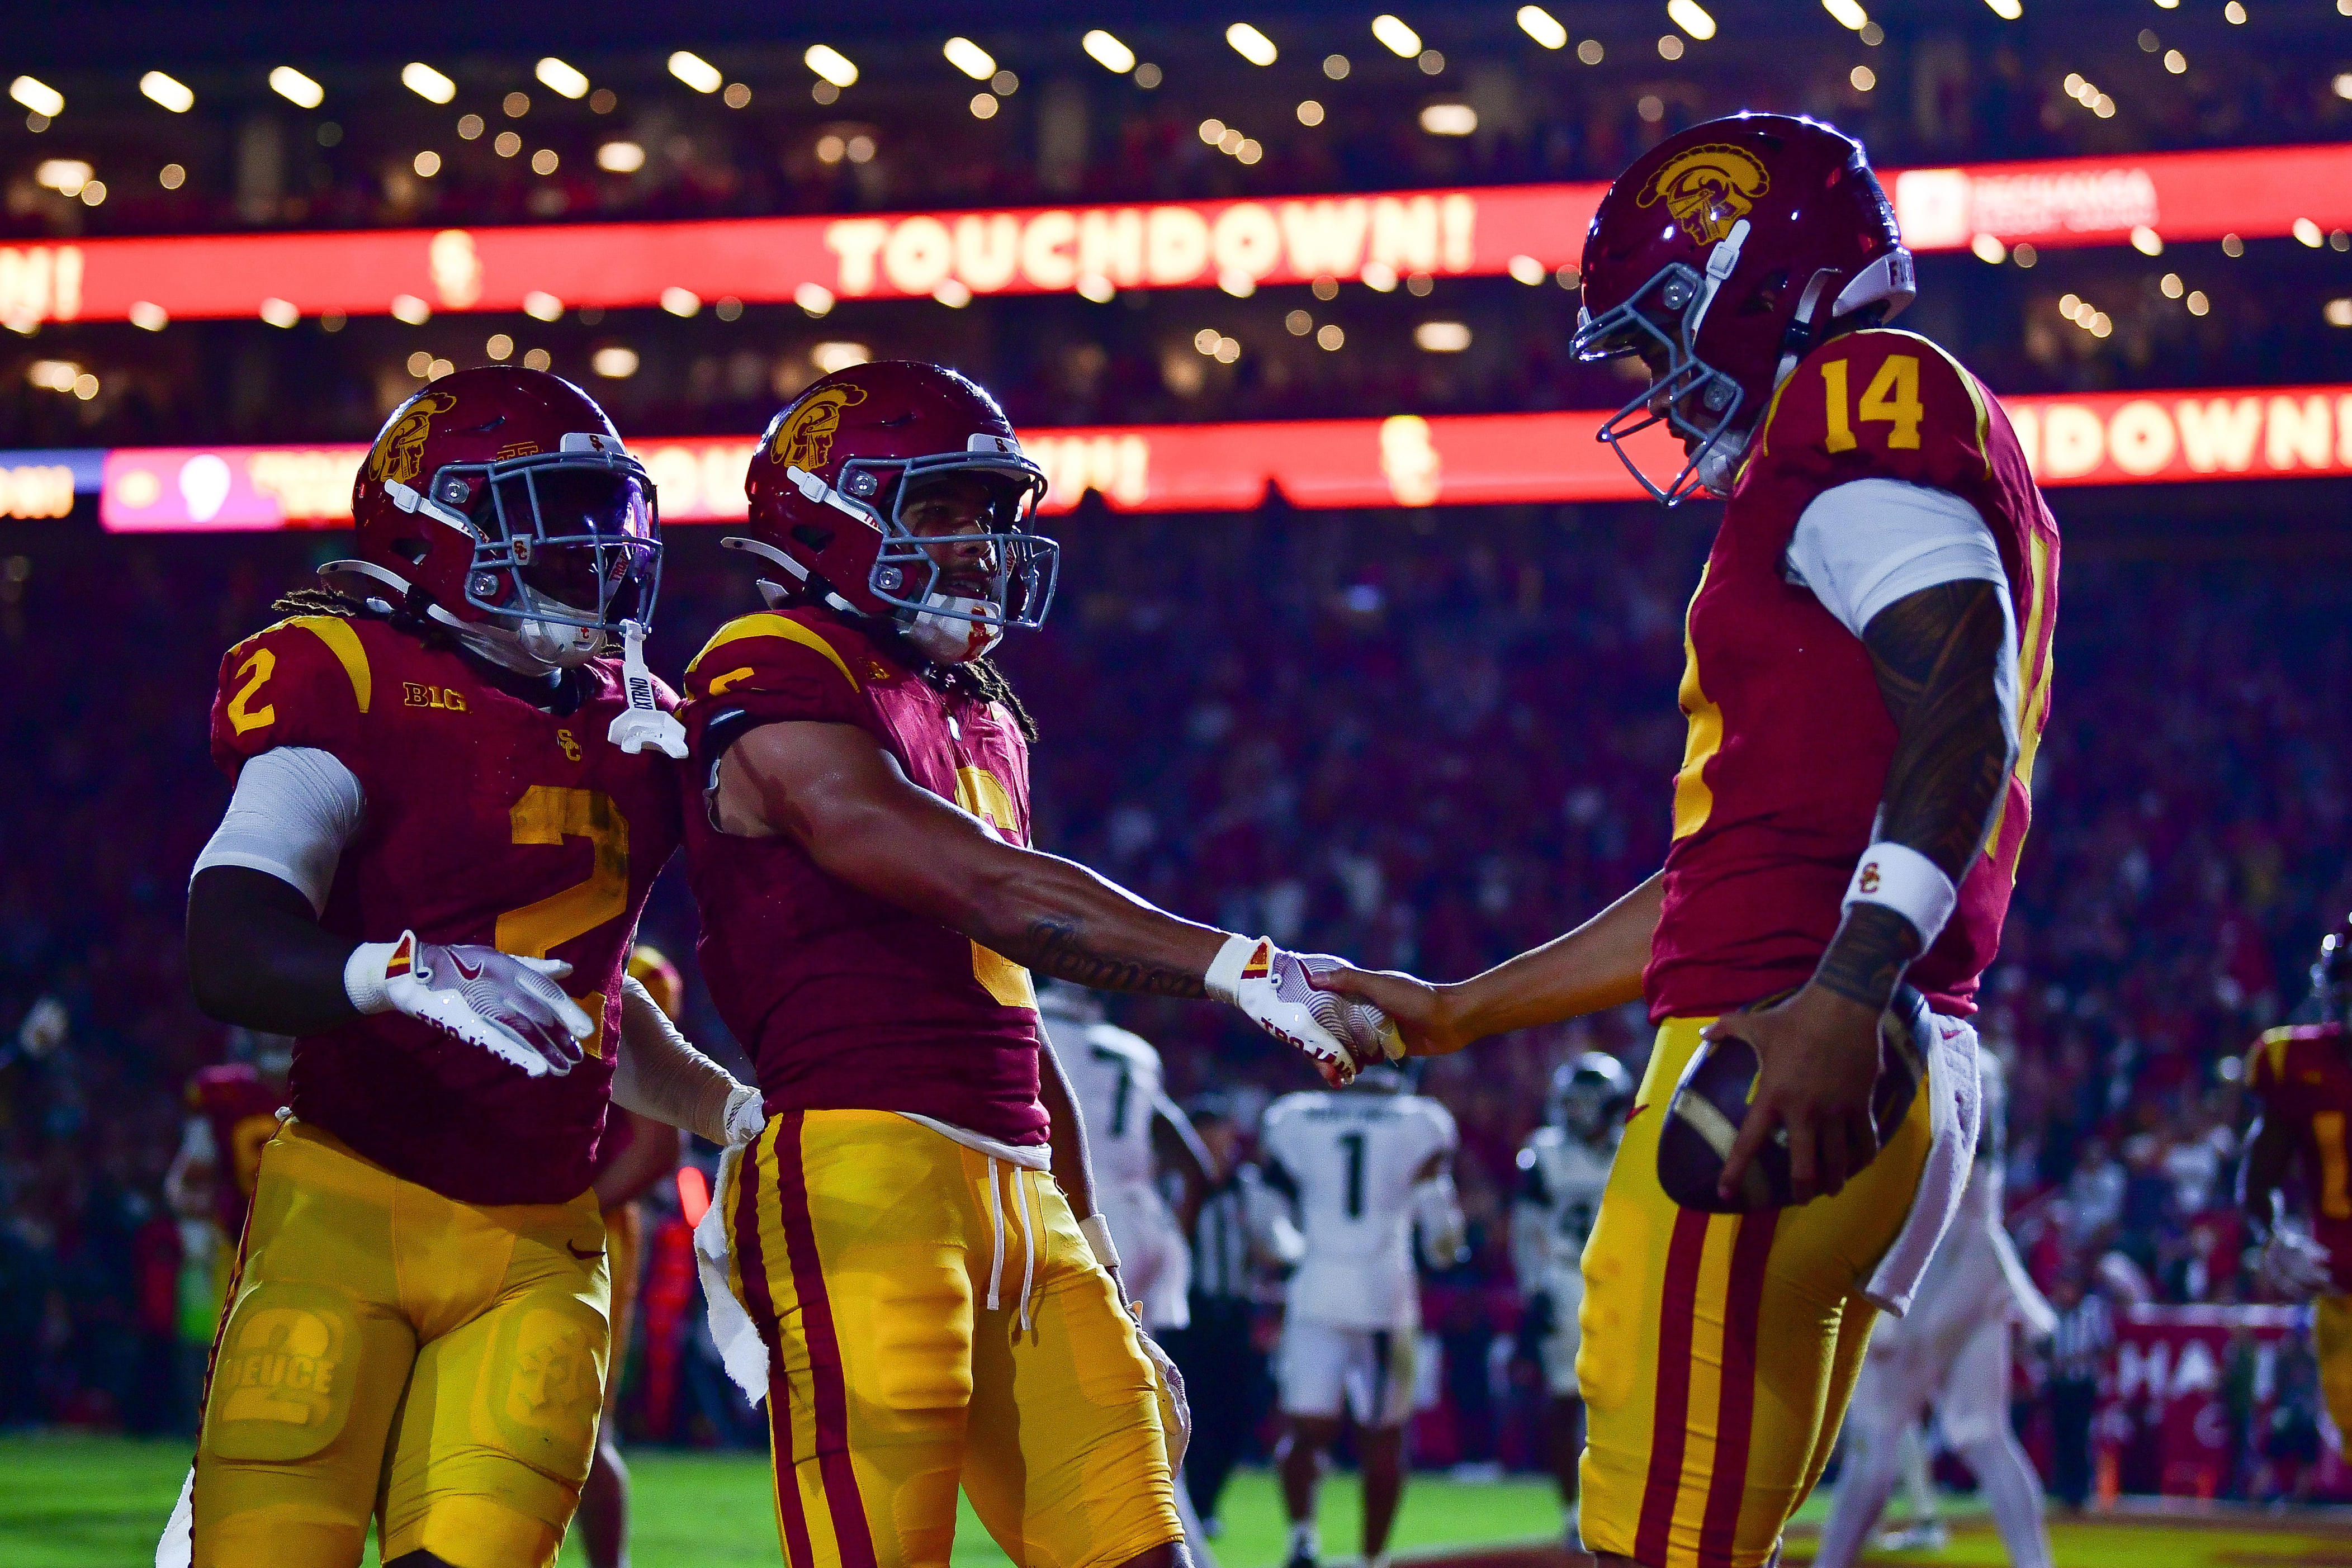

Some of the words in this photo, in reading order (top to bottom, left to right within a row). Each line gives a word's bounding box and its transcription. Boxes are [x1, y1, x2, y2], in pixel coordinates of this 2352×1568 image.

[826, 194, 1474, 295] TOUCHDOWN!
[1821, 354, 1923, 453] 14
[228, 647, 276, 737] 2
[557, 729, 581, 761] SC
[494, 785, 630, 1058] 2
[1337, 1131, 1367, 1219] 1
